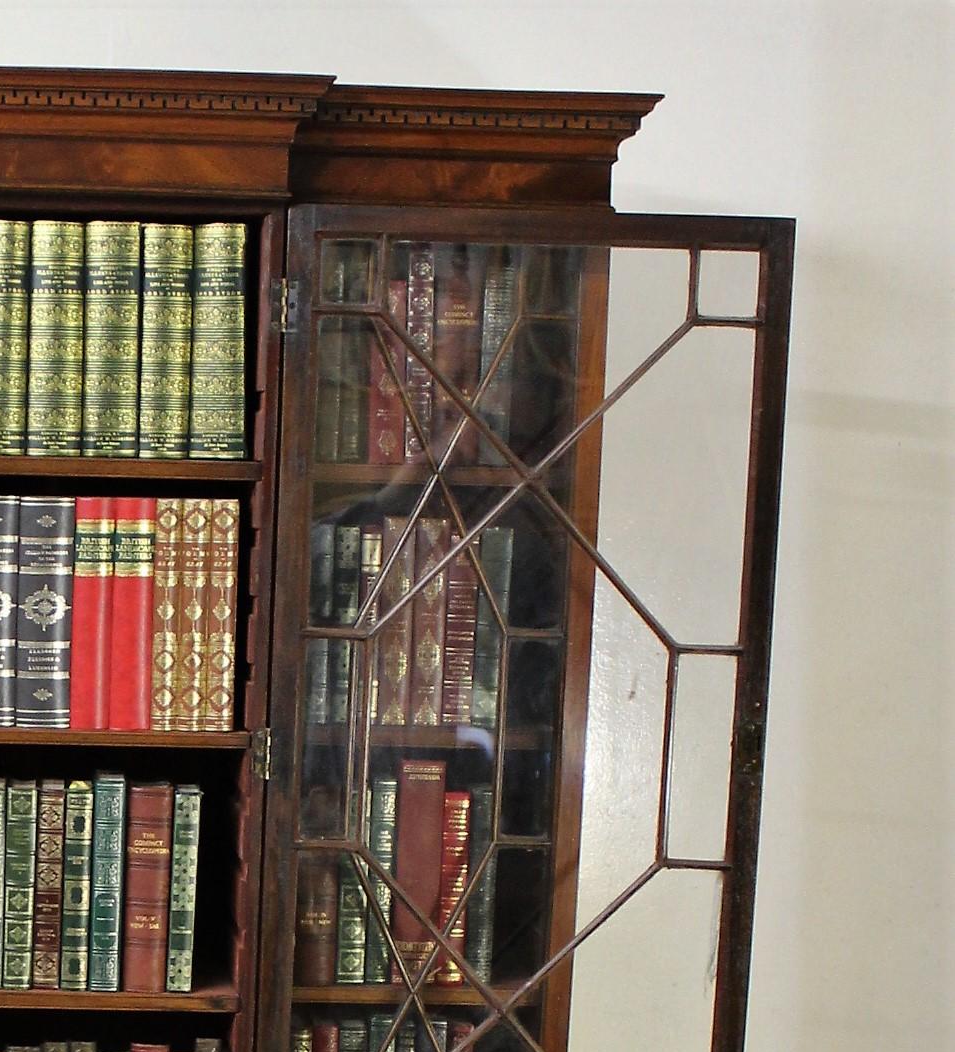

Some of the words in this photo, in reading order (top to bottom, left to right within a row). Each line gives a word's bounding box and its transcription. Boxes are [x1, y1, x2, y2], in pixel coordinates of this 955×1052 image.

[80, 537, 111, 545] BRITISH
[121, 537, 151, 545] BRITISH
[78, 552, 112, 560] PAINTERS
[118, 552, 152, 560] PAINTERS
[134, 839, 164, 847] COMPACT
